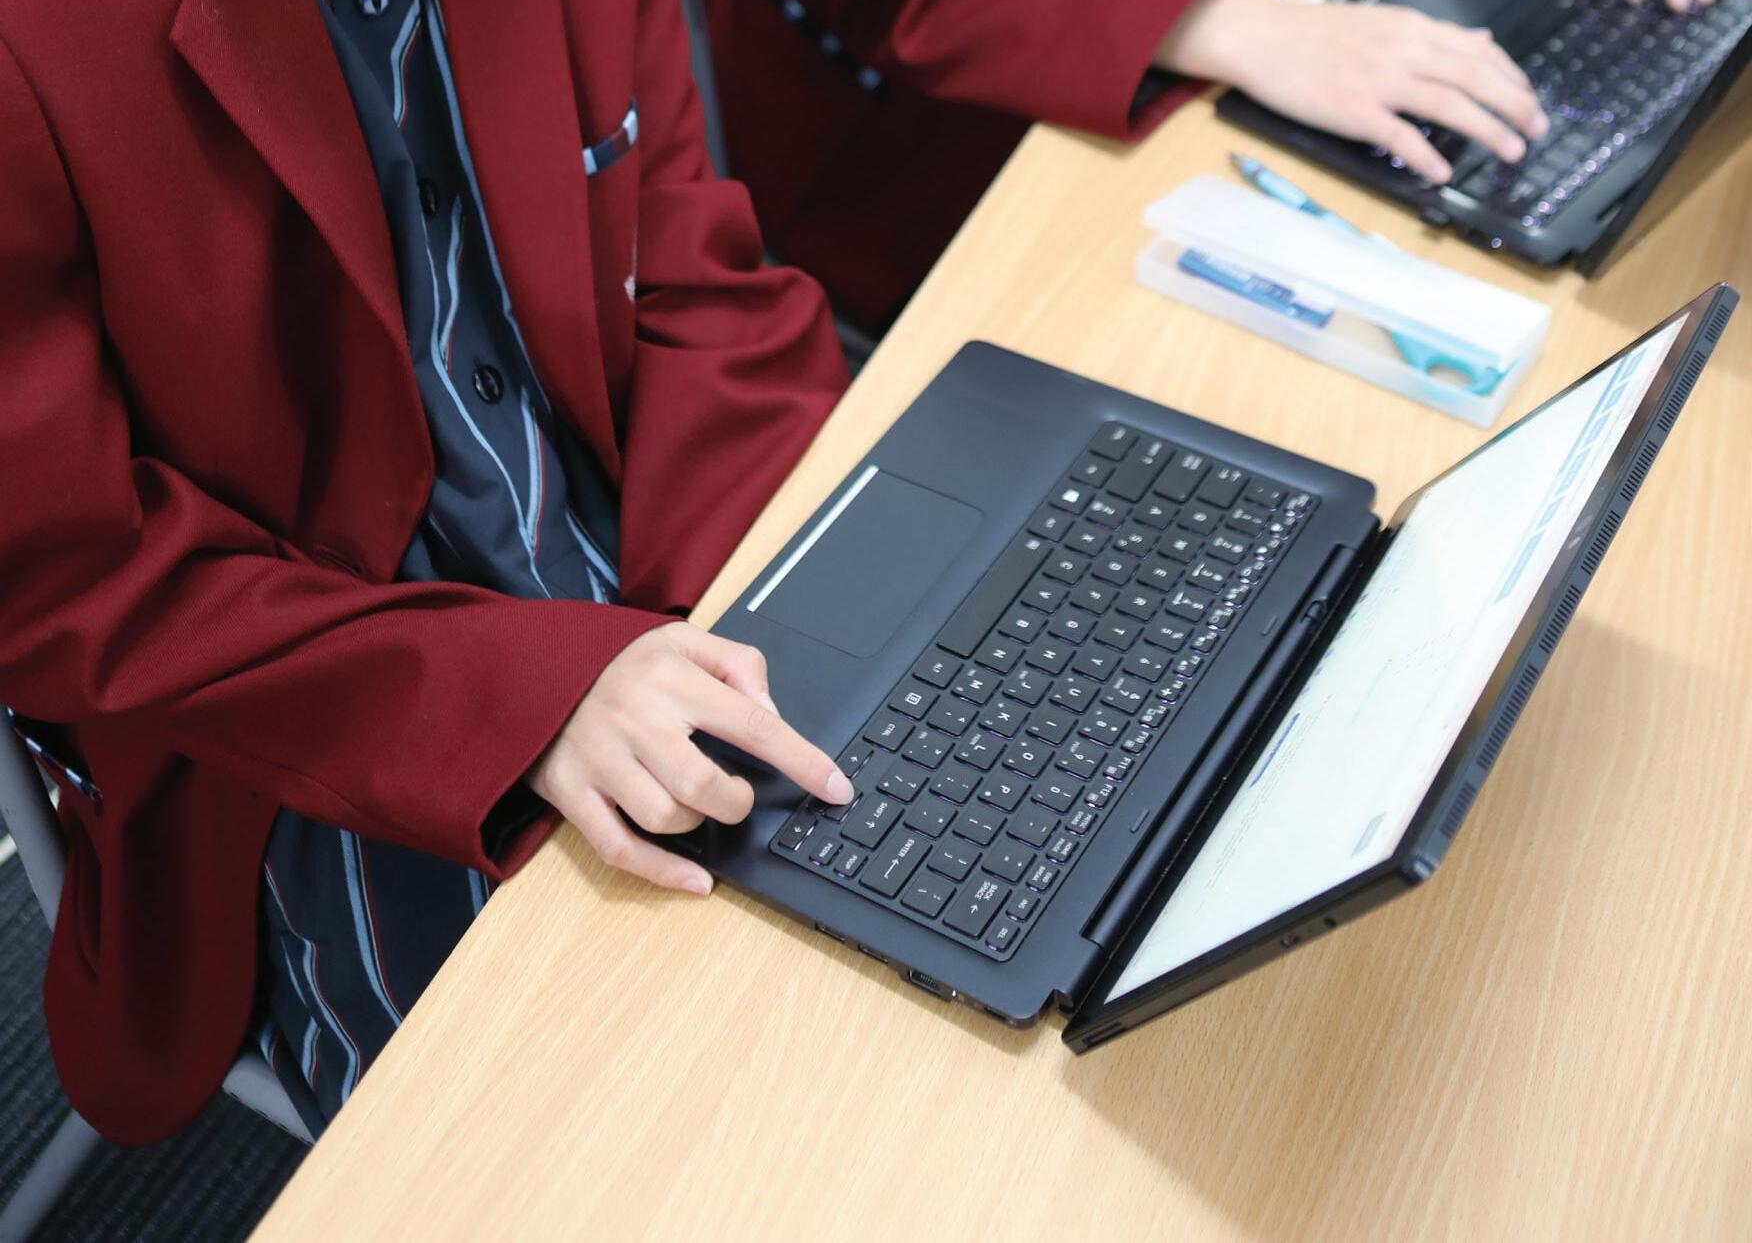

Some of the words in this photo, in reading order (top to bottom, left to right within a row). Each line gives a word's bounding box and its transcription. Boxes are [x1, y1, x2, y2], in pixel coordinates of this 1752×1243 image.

[1130, 535, 1143, 543] S
[1039, 591, 1052, 599] V
[993, 649, 1006, 658] N
[1043, 650, 1056, 659] H
[933, 663, 943, 673] ALT
[970, 680, 983, 689] M
[1069, 688, 1081, 696] U
[998, 712, 1010, 721] K
[881, 723, 895, 736] CTRL
[1135, 731, 1149, 743] F10
[1022, 752, 1034, 760] O
[1118, 757, 1131, 769] F11
[1000, 785, 1011, 794] P
[1099, 784, 1113, 796] F12
[873, 802, 888, 818] SHIFT
[819, 843, 833, 858] PGDN
[897, 839, 915, 857] ENTER
[845, 855, 858, 870] PGUP
[974, 881, 991, 899] SPACE
[983, 884, 998, 900] BACK
[997, 927, 1008, 938] DEL
